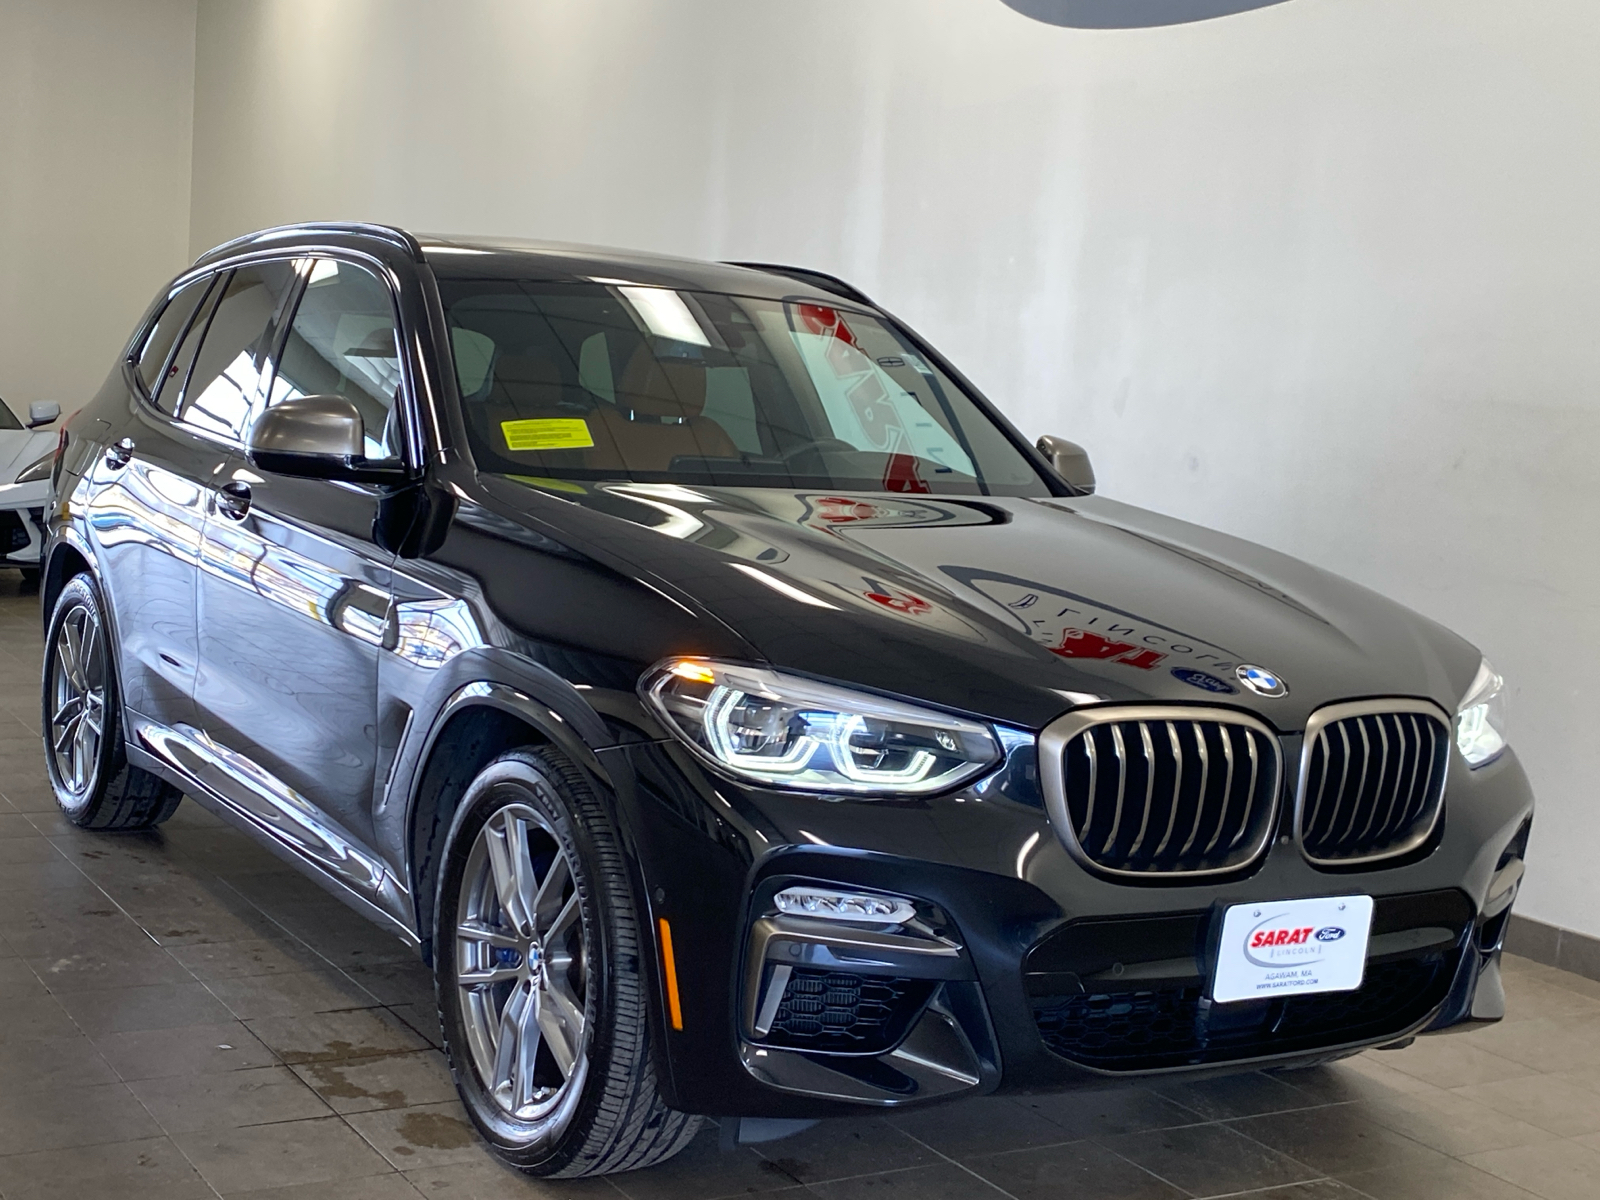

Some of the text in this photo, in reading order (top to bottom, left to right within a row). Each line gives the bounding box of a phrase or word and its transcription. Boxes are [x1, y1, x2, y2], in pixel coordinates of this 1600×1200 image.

[1251, 927, 1313, 948] SARAT
[1318, 928, 1342, 941] Ford
[1265, 971, 1299, 980] AGAWAM,
[1256, 979, 1319, 990] WWW.SARATFORD.COM
